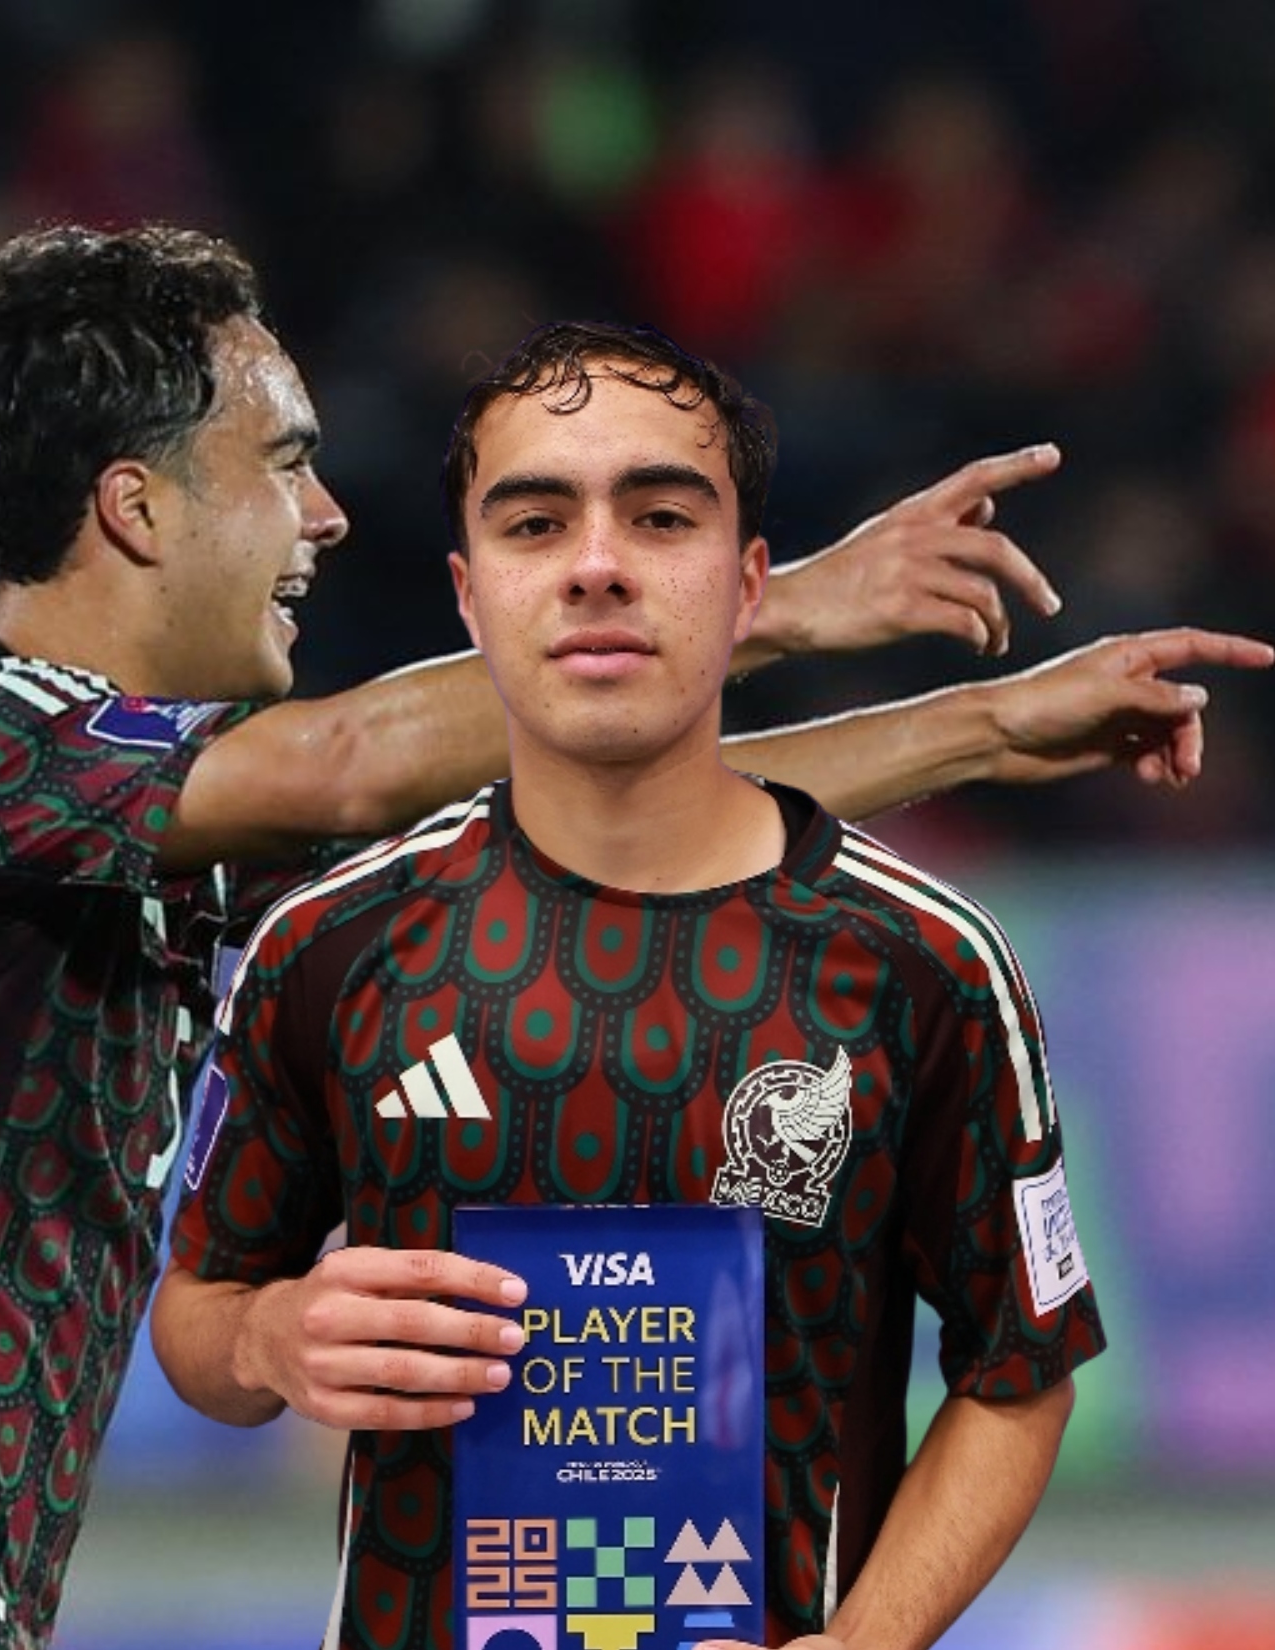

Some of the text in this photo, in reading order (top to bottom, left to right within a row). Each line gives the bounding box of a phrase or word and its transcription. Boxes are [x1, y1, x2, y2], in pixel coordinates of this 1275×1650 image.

[559, 1252, 655, 1285] VISA
[523, 1307, 695, 1343] PLAYER
[523, 1357, 695, 1393] OF THE
[524, 1407, 695, 1445] MATCH
